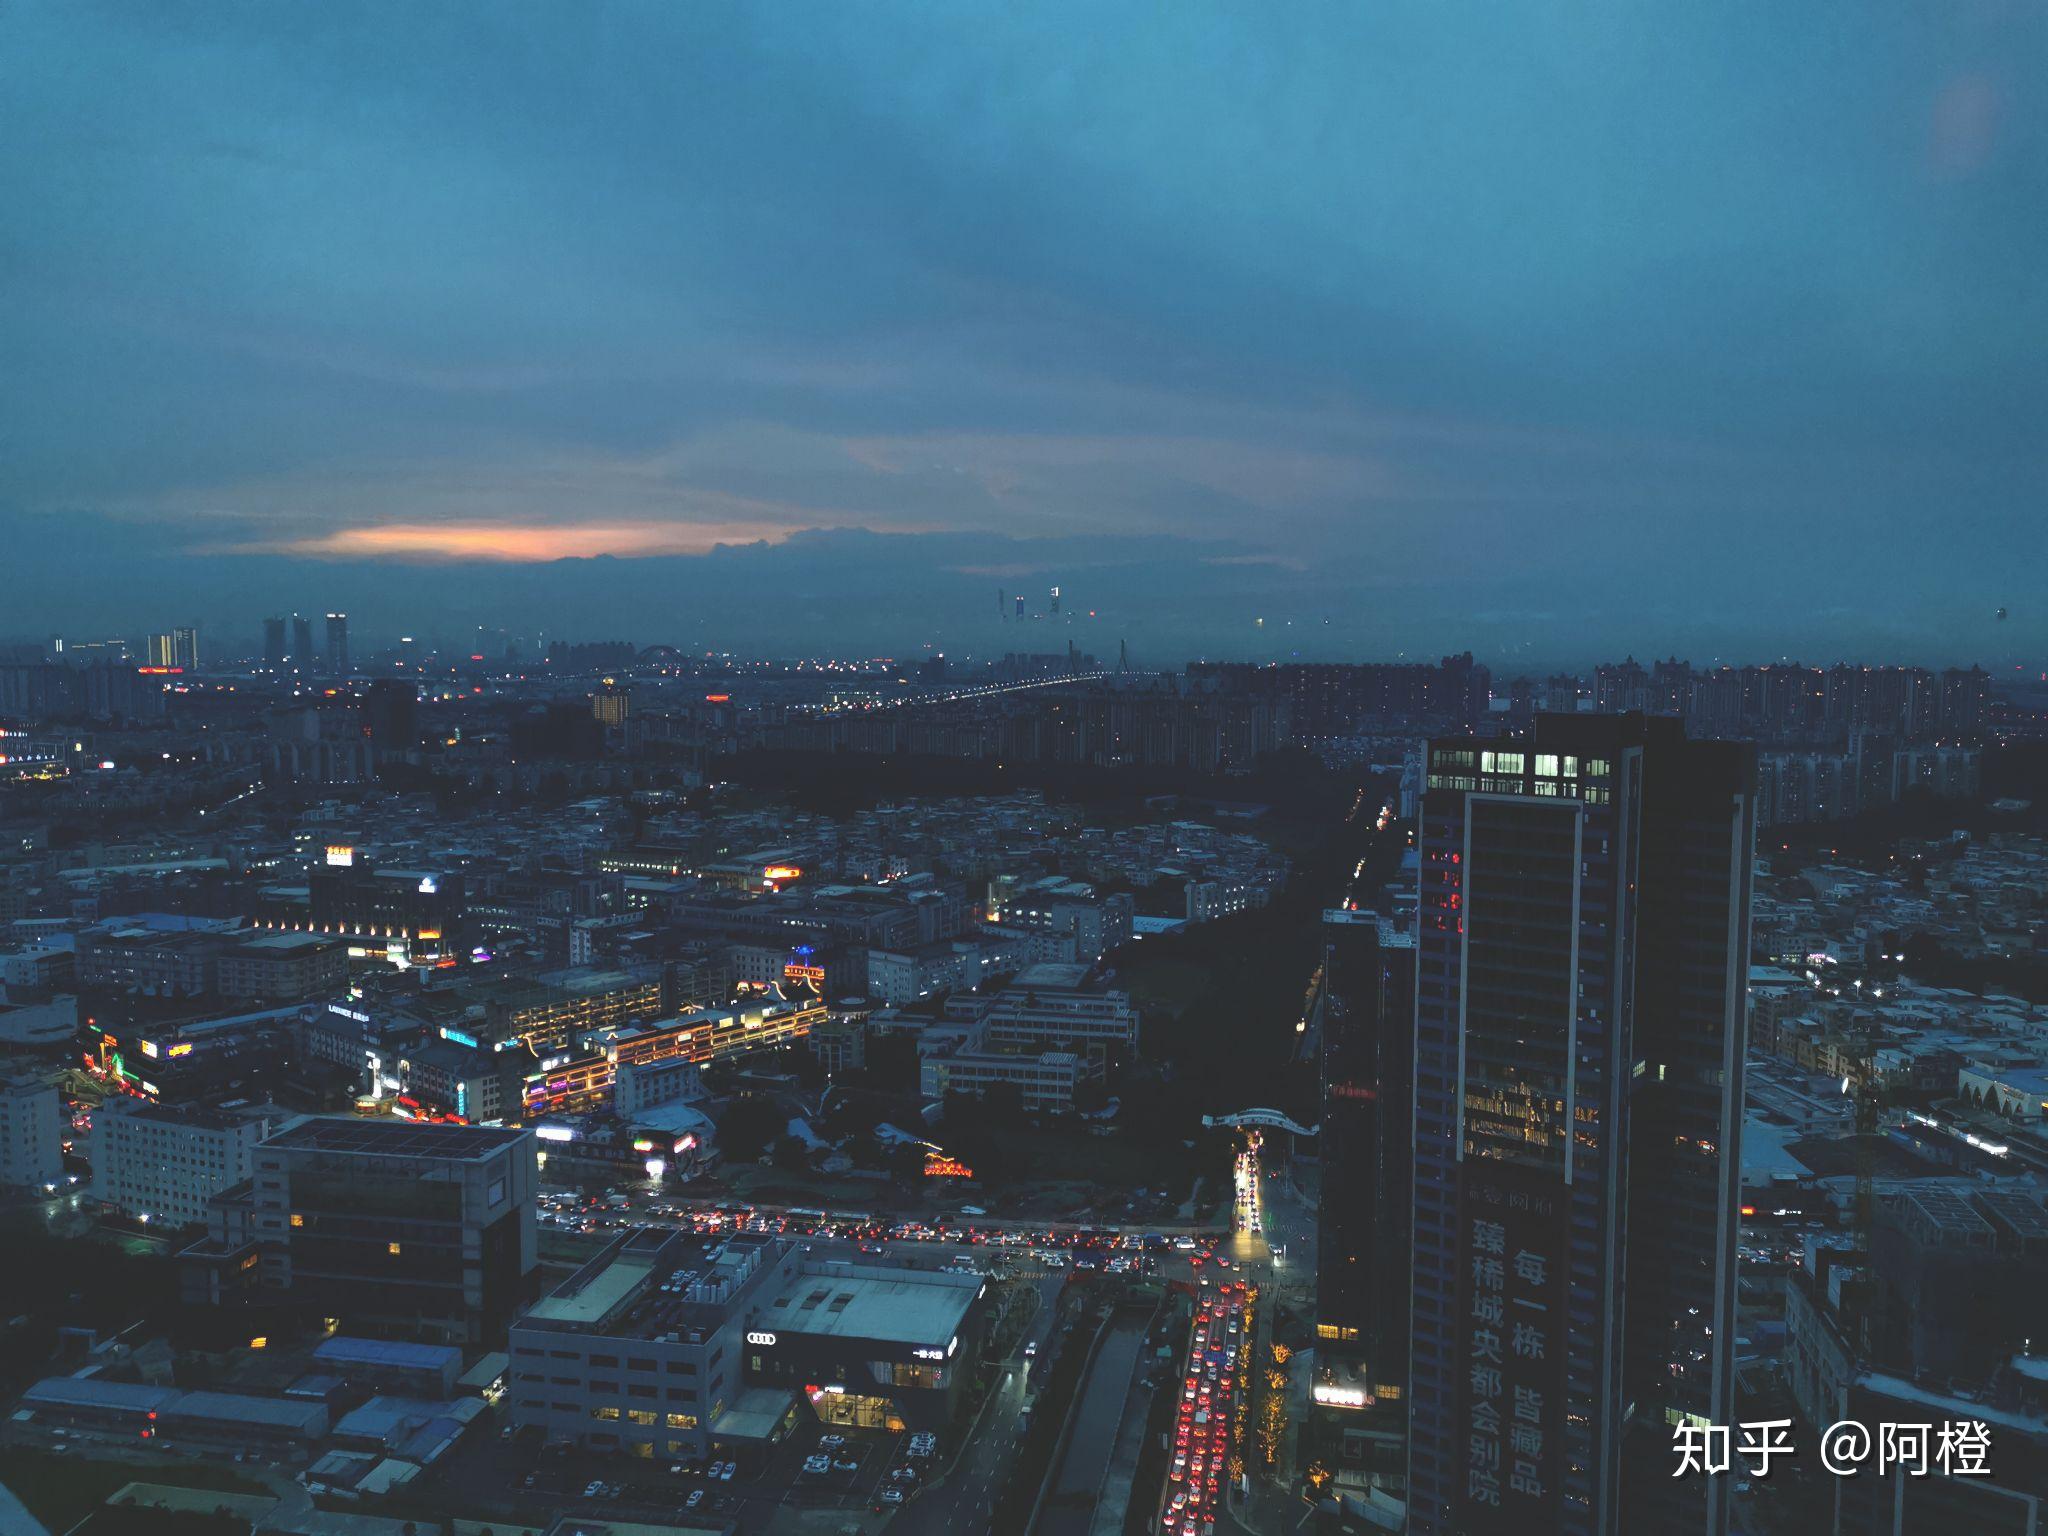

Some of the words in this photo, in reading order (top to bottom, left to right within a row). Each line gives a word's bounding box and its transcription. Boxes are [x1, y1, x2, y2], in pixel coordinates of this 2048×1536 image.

[1469, 1219, 1504, 1506] 臻稀城央都会别院
